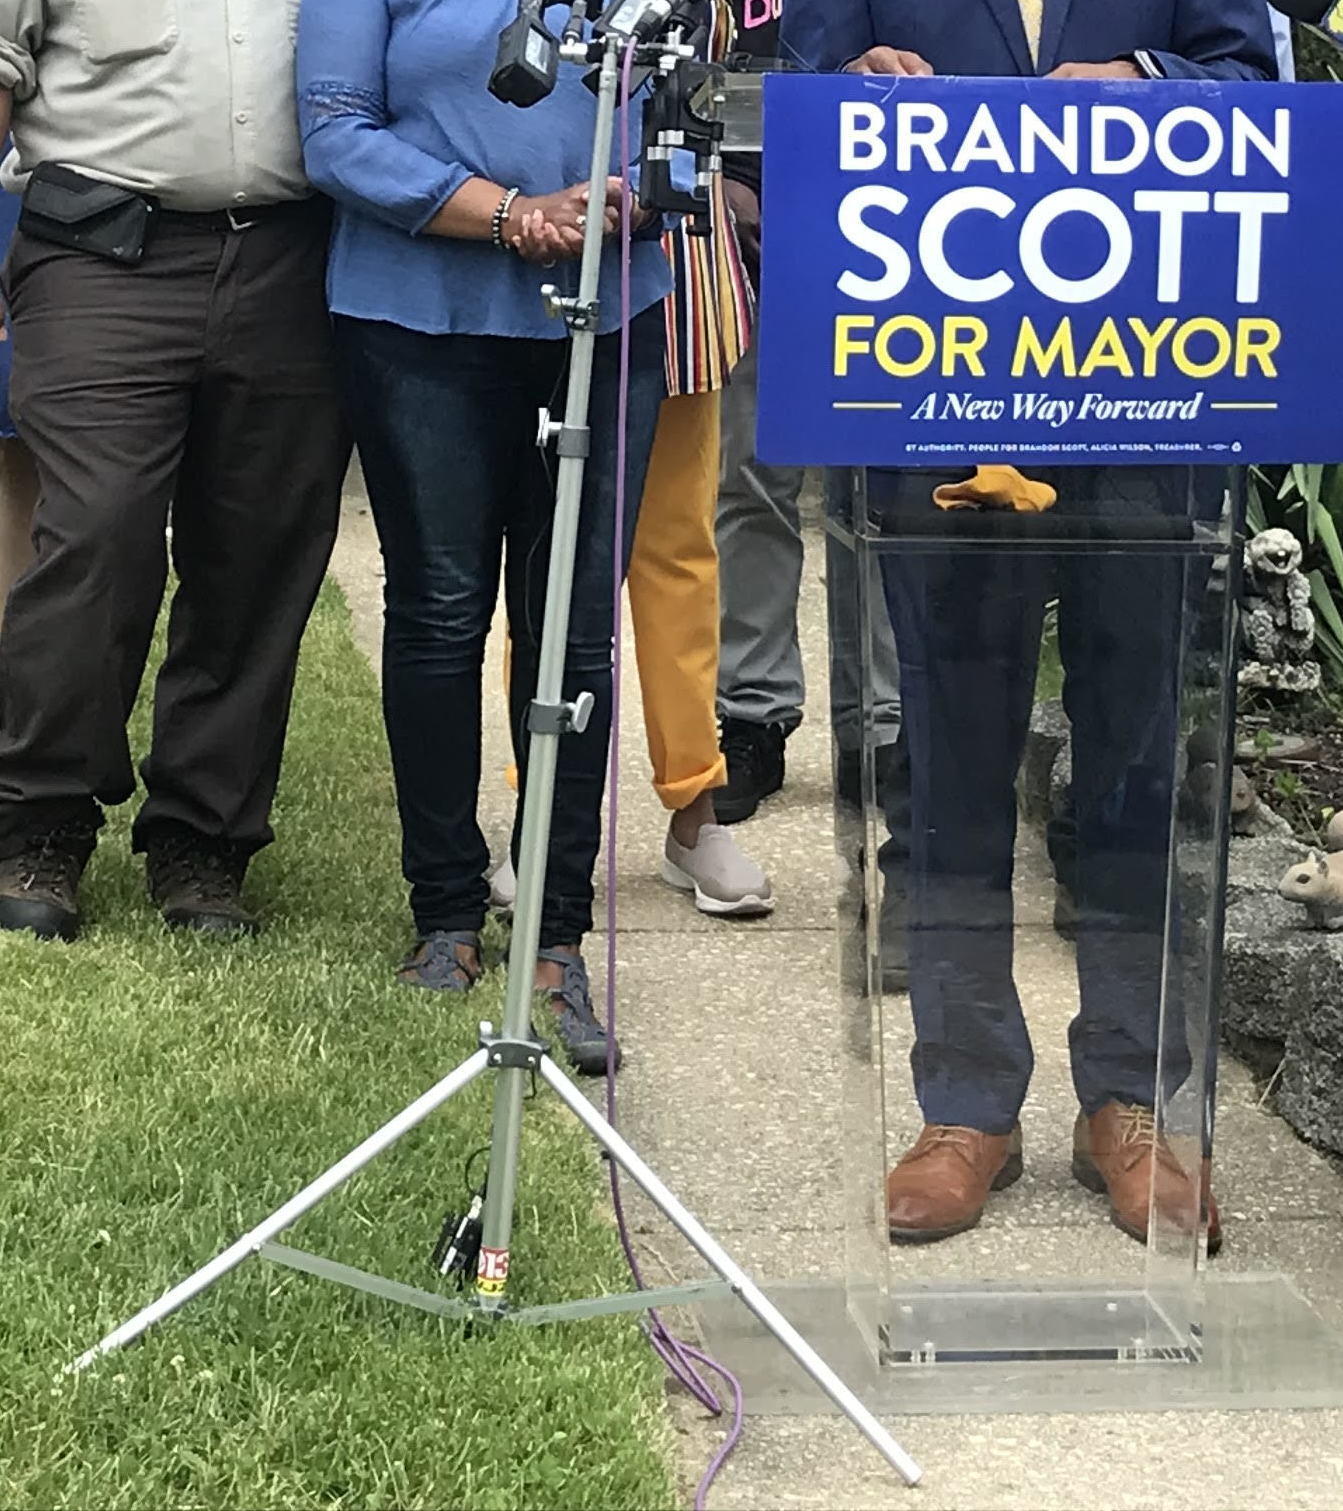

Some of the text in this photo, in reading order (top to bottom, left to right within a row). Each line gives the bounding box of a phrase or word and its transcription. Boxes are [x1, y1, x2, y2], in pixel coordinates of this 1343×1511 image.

[839, 101, 1290, 178] BRANDON
[836, 185, 1290, 304] SCOTT
[833, 315, 1282, 378] FOR MAYOR
[909, 391, 1205, 428] A New Way Forward
